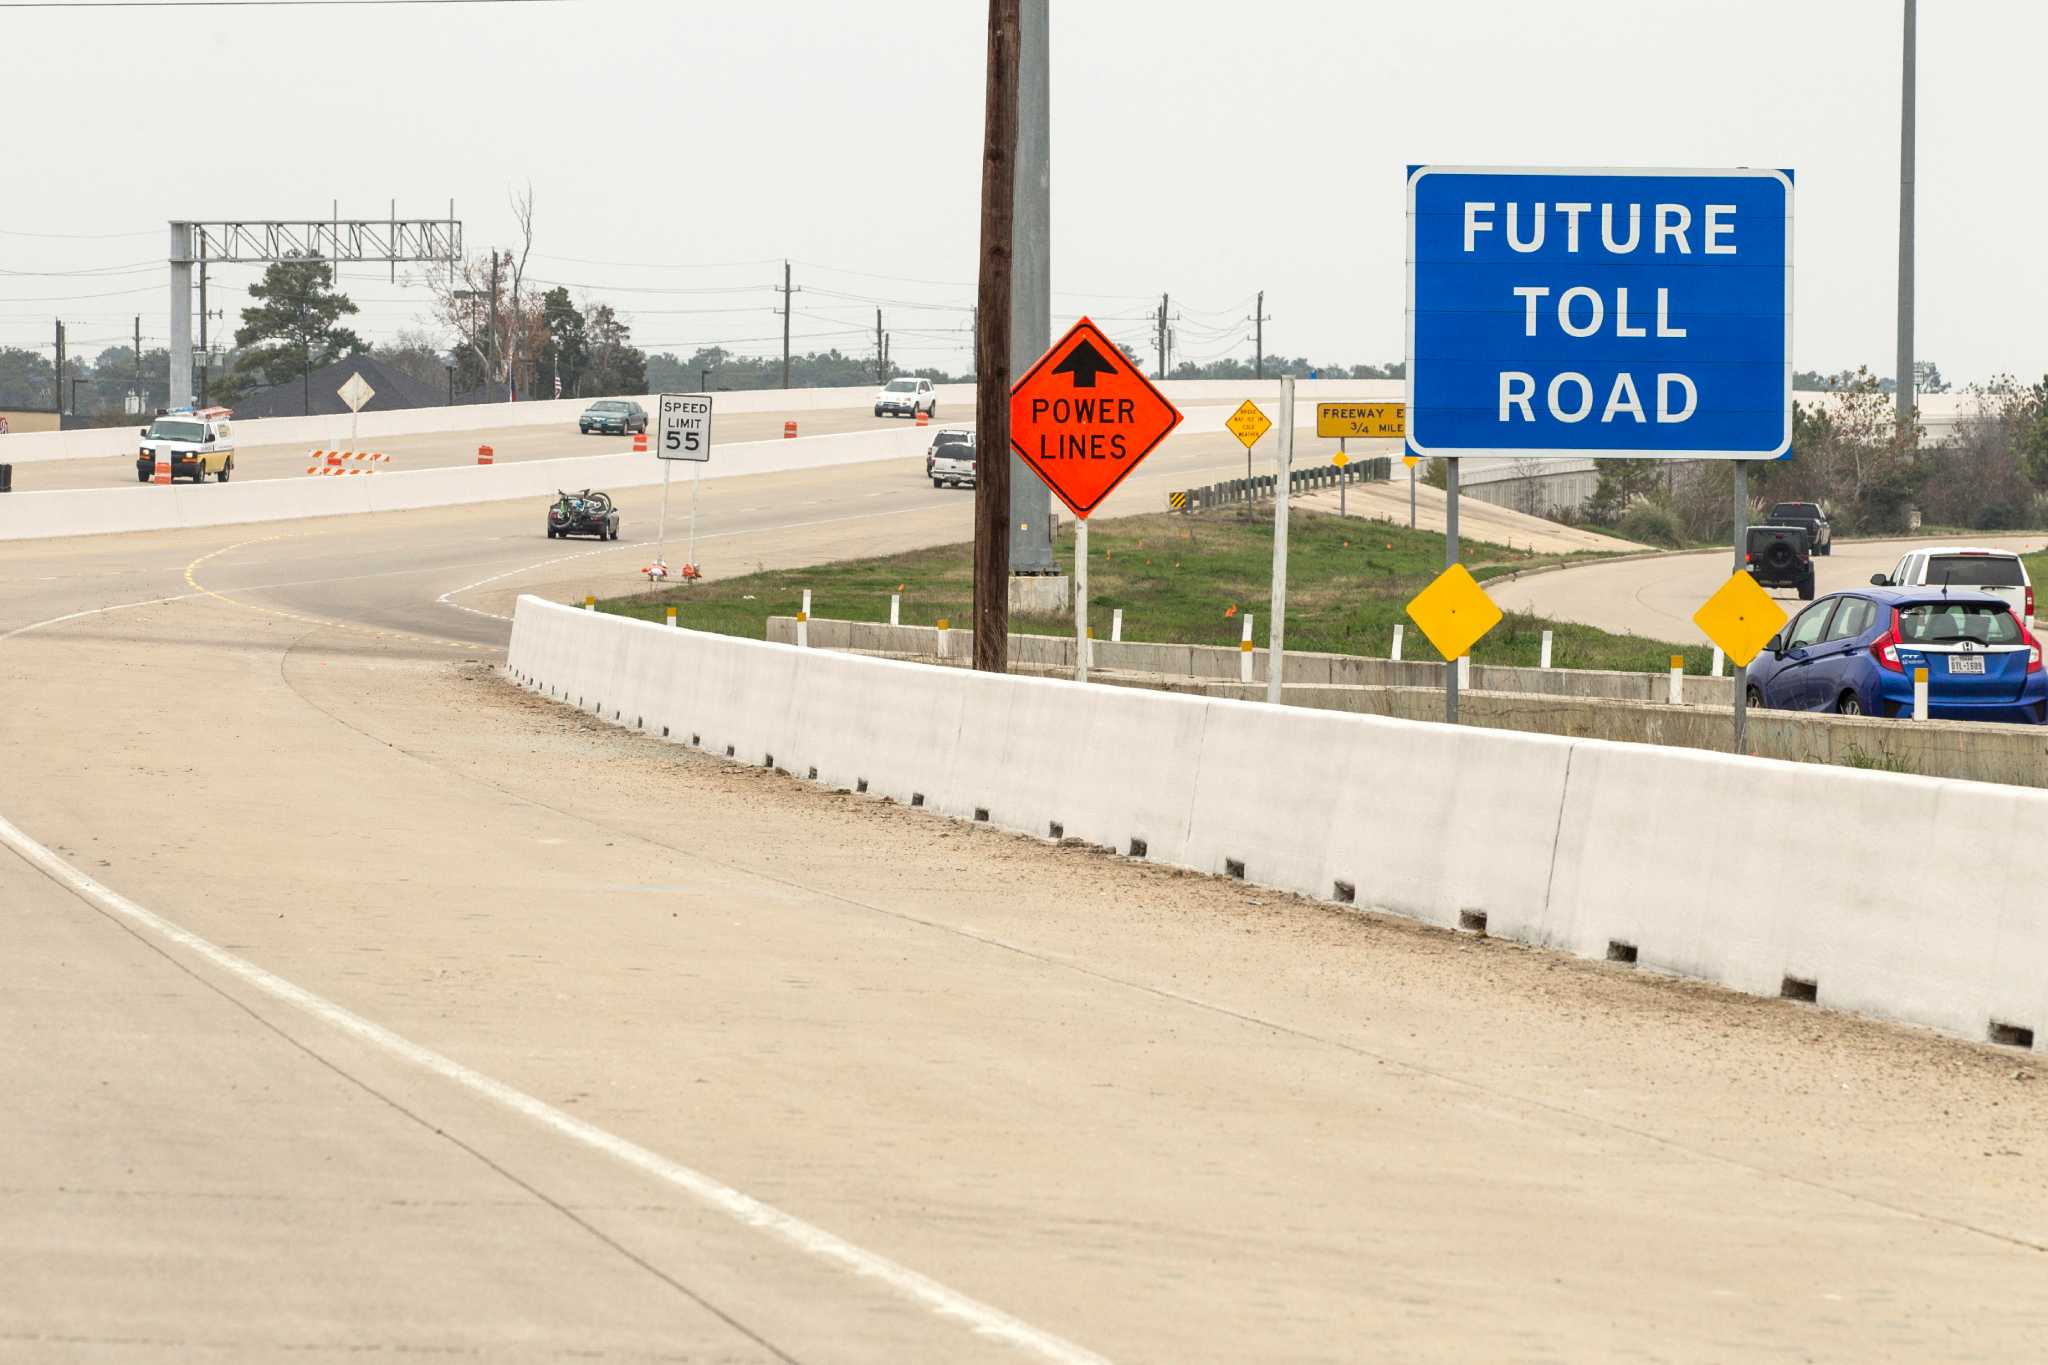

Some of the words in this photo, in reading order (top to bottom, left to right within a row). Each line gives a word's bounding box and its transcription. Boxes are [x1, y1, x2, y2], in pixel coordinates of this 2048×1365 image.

[1463, 201, 1737, 255] FUTURE
[1512, 285, 1688, 339] TOLL
[664, 402, 708, 414] SPEED
[1497, 371, 1699, 425] ROAD
[1032, 398, 1135, 424] POWER
[1322, 408, 1385, 419] FREEWAY
[668, 417, 702, 429] LIMIT
[1378, 423, 1404, 433] MILE
[666, 430, 699, 451] 55
[1040, 433, 1127, 461] LINES
